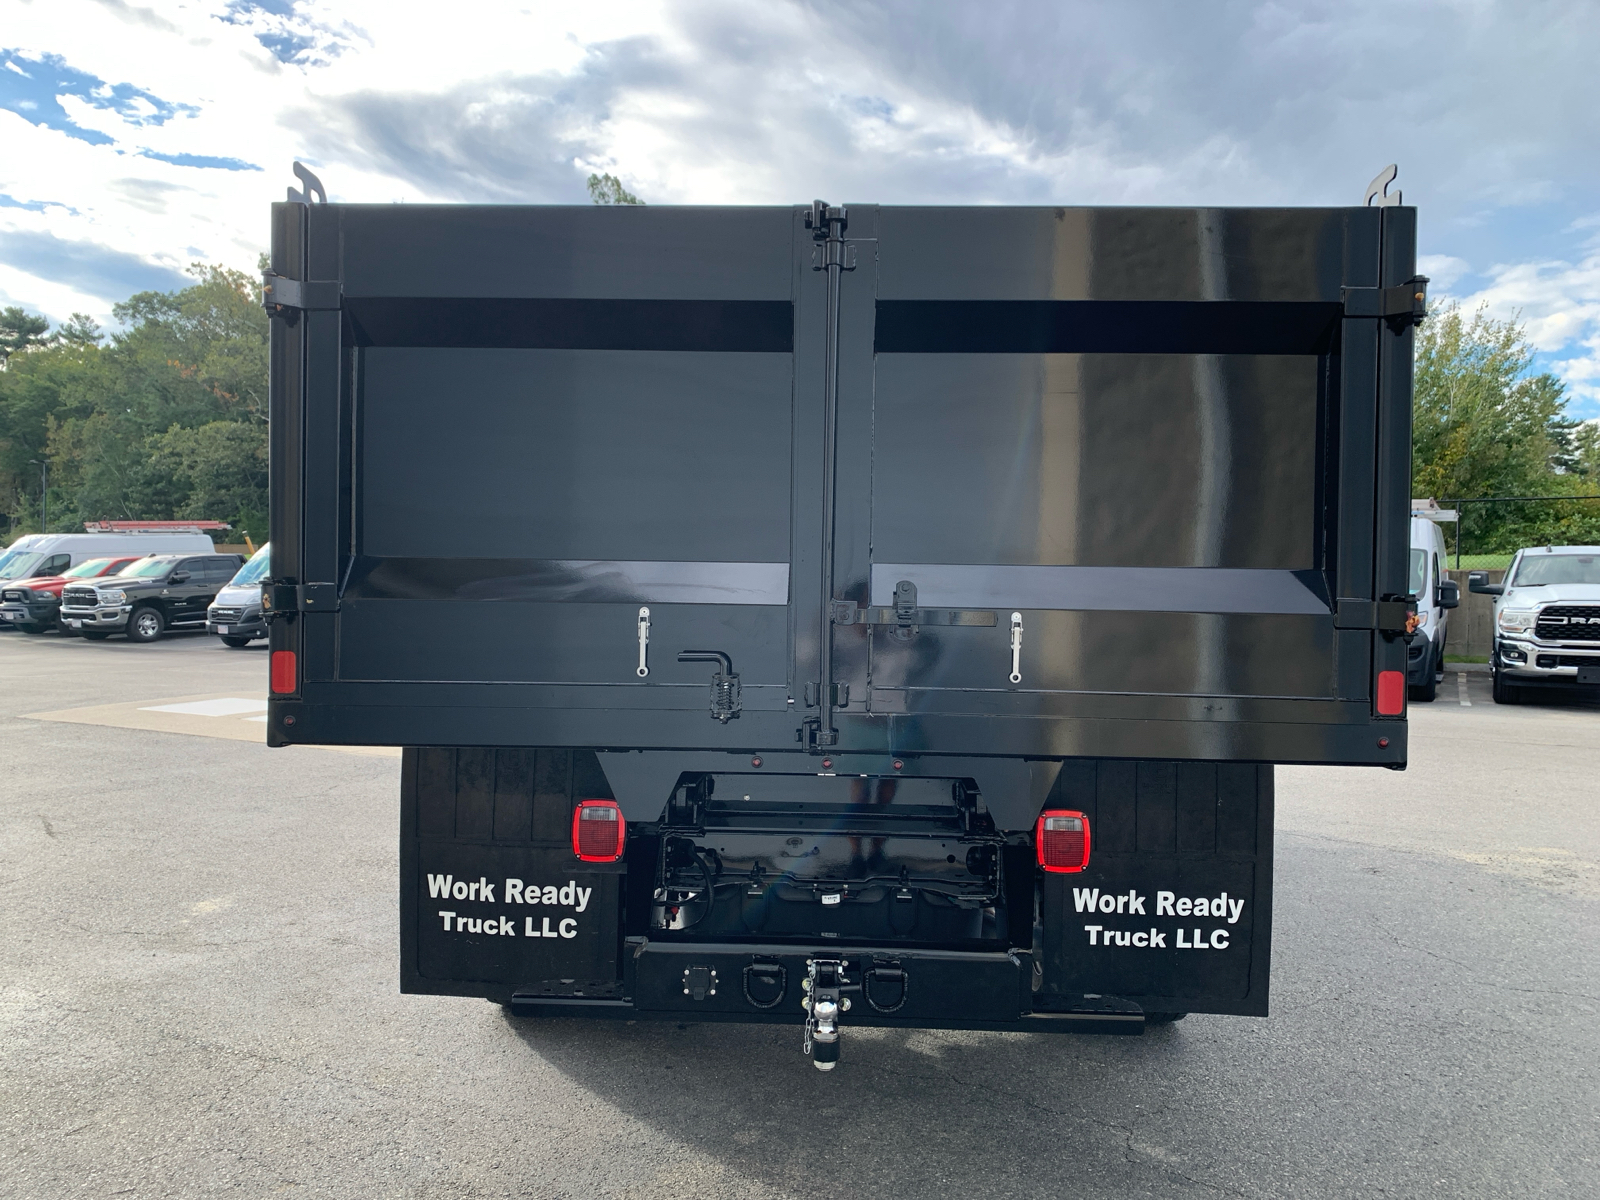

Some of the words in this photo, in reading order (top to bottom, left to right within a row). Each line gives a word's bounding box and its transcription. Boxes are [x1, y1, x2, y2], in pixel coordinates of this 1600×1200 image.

[1570, 616, 1600, 625] RA
[427, 873, 496, 903] Work
[504, 878, 592, 913] Ready
[1072, 887, 1146, 915] Work
[1156, 890, 1245, 924] Ready
[438, 910, 516, 937] Truck
[524, 916, 578, 939] LLC
[1084, 925, 1167, 948] Truck
[1176, 928, 1230, 950] LLC
